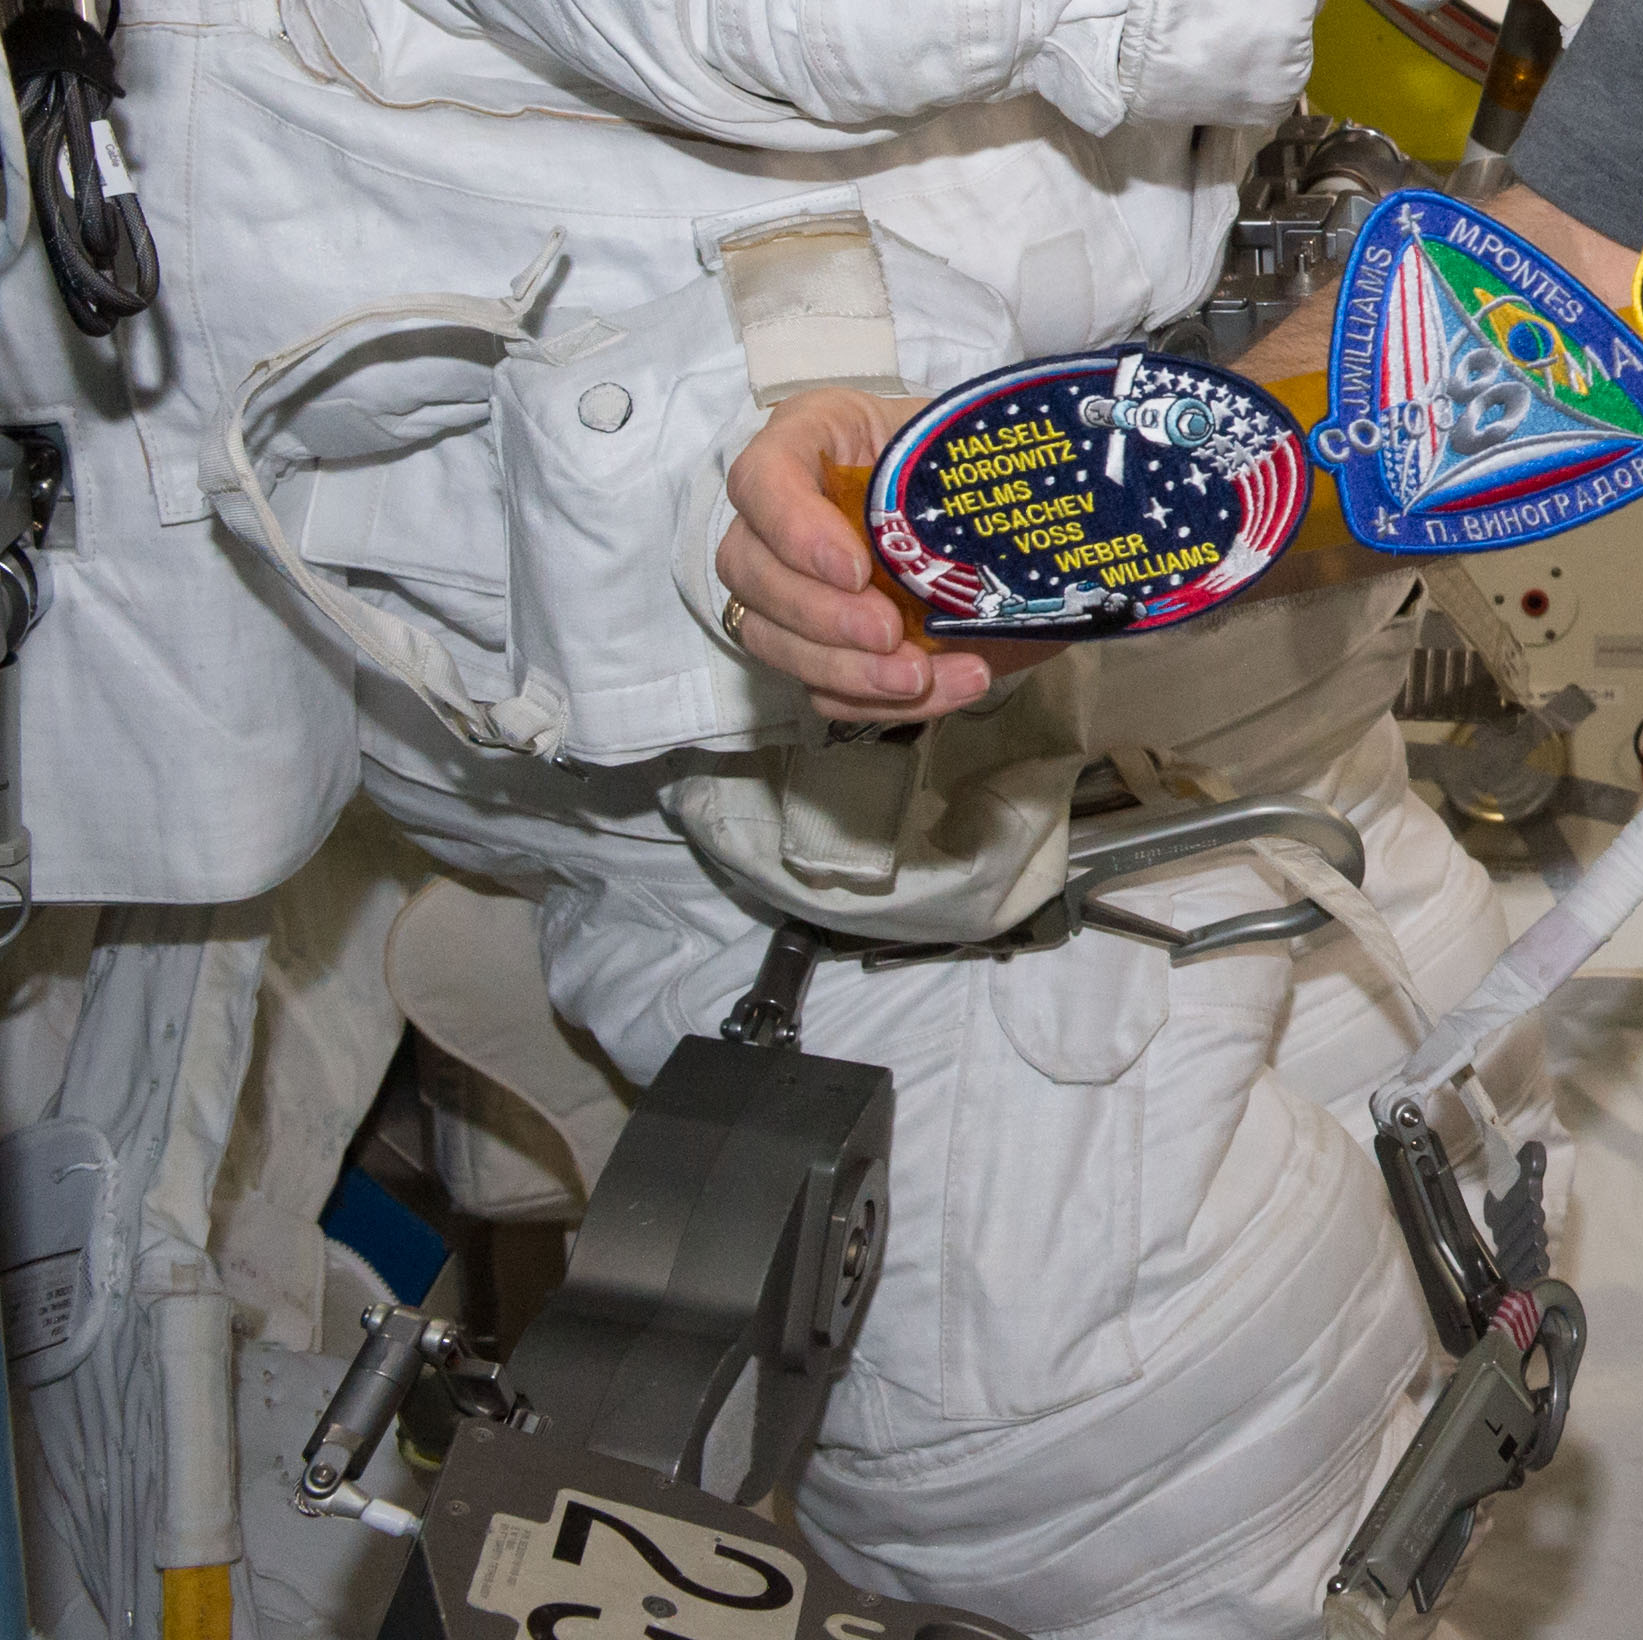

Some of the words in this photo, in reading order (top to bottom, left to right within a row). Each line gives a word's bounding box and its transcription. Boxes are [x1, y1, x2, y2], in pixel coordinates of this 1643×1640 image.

[1448, 217, 1586, 325] M.PONTES
[946, 418, 1066, 461] HALSELL
[940, 440, 1077, 490] HOROWITZ
[942, 480, 1033, 518] HELMS
[973, 492, 1095, 537] USACHEV
[1014, 522, 1085, 555] VOSS
[1055, 533, 1148, 572] WEBER
[1101, 542, 1220, 589] WILLIAMS
